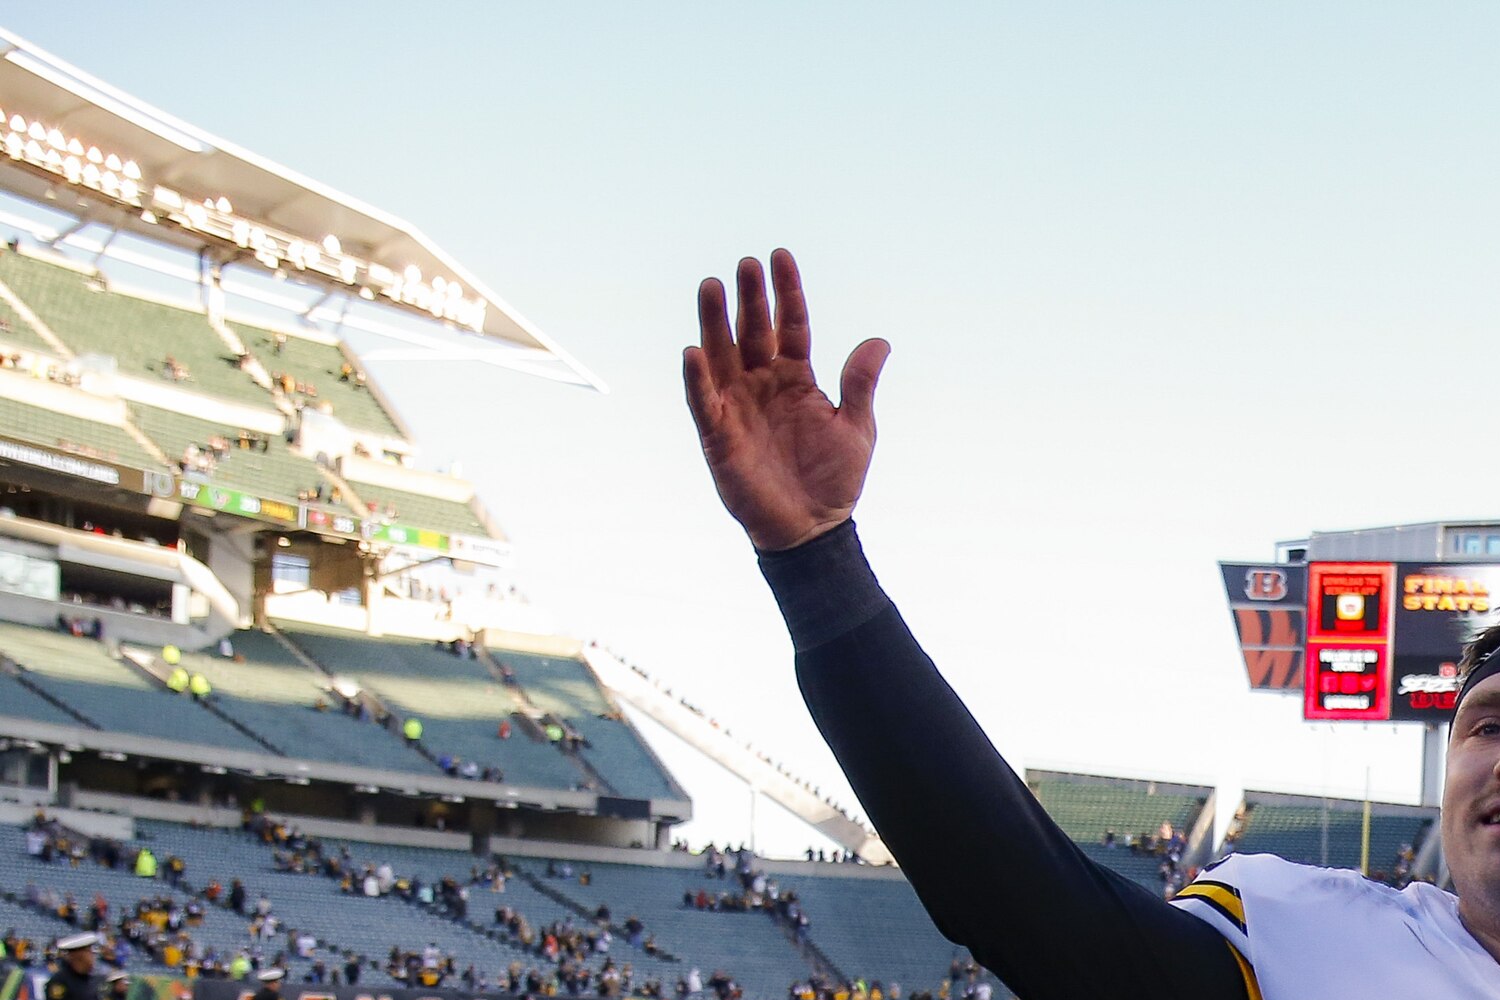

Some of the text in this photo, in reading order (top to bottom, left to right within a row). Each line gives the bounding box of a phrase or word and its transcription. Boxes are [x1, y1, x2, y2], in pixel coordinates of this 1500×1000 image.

[1245, 568, 1288, 601] B
[1403, 574, 1490, 595] FINAL
[1402, 596, 1490, 612] STATS
